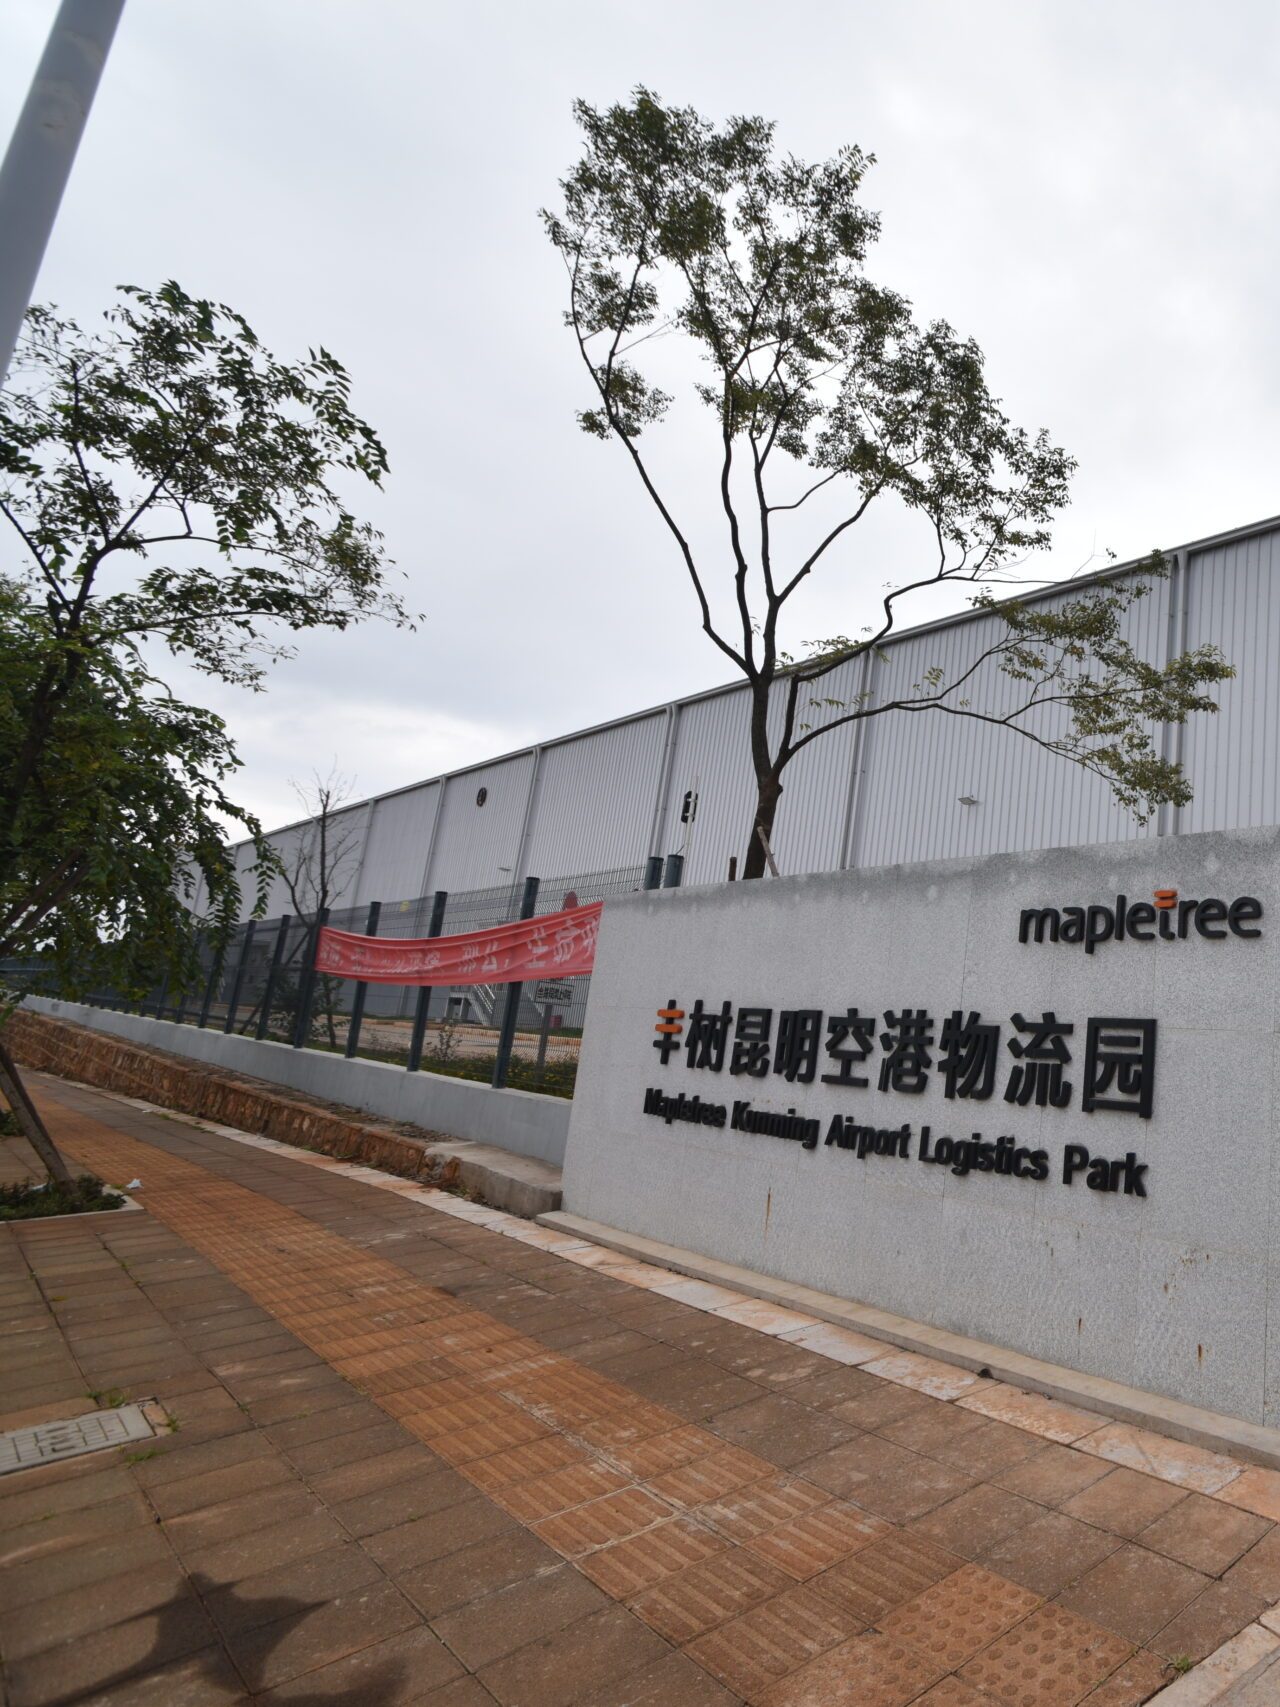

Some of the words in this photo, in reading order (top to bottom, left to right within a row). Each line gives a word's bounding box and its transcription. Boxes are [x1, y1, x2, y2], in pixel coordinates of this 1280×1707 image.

[1018, 890, 1263, 953] mapletree
[653, 1000, 1157, 1119] 丰树昆明空港物流园
[643, 1087, 727, 1126] Mapletree
[731, 1101, 820, 1149] Kunming
[824, 1115, 910, 1159] Airport
[918, 1126, 1049, 1177] Logistics
[1063, 1144, 1147, 1197] Park
